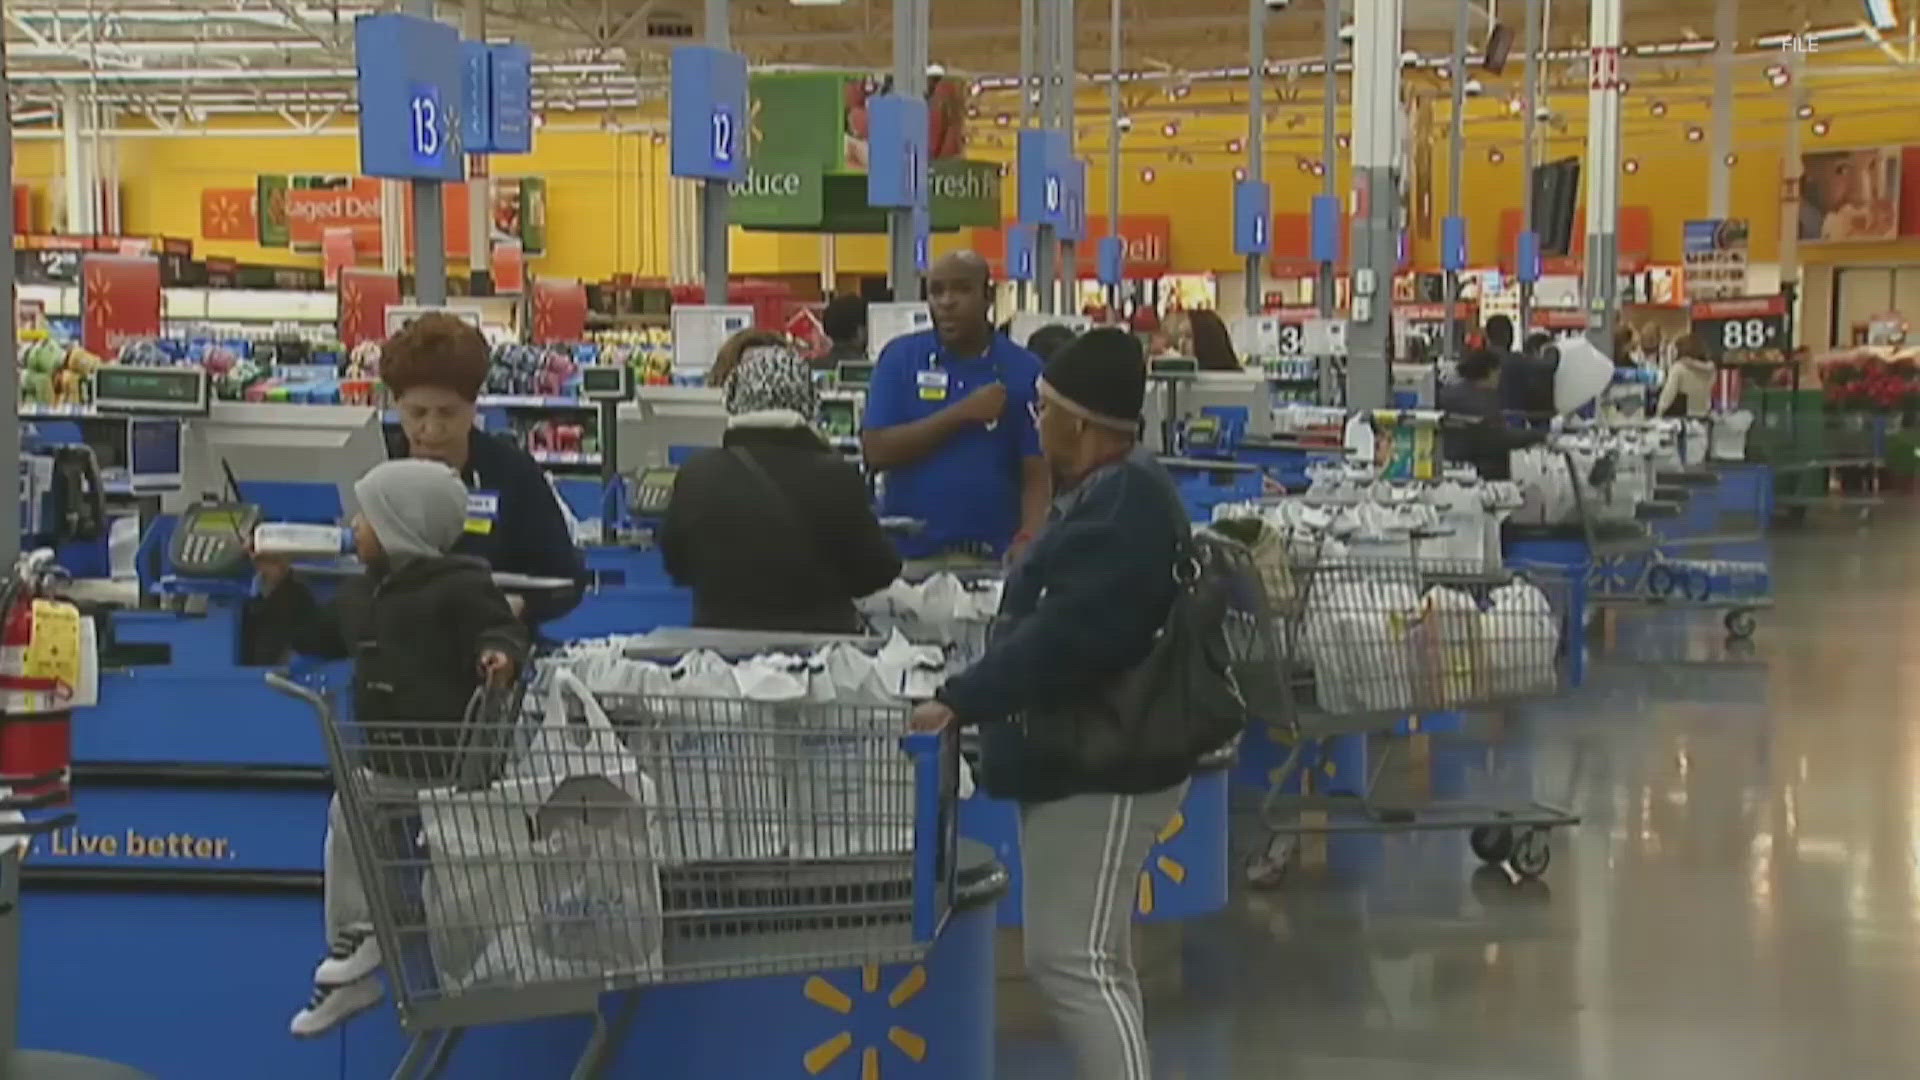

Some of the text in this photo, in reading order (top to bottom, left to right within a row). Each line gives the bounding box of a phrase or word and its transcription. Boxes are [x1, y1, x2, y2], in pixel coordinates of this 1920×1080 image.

[412, 96, 437, 156] 13
[713, 113, 731, 161] 12
[727, 166, 800, 197] oduce
[1046, 175, 1060, 212] 10
[284, 196, 382, 224] aged Del
[53, 826, 118, 857] Live
[126, 828, 236, 860] better.
